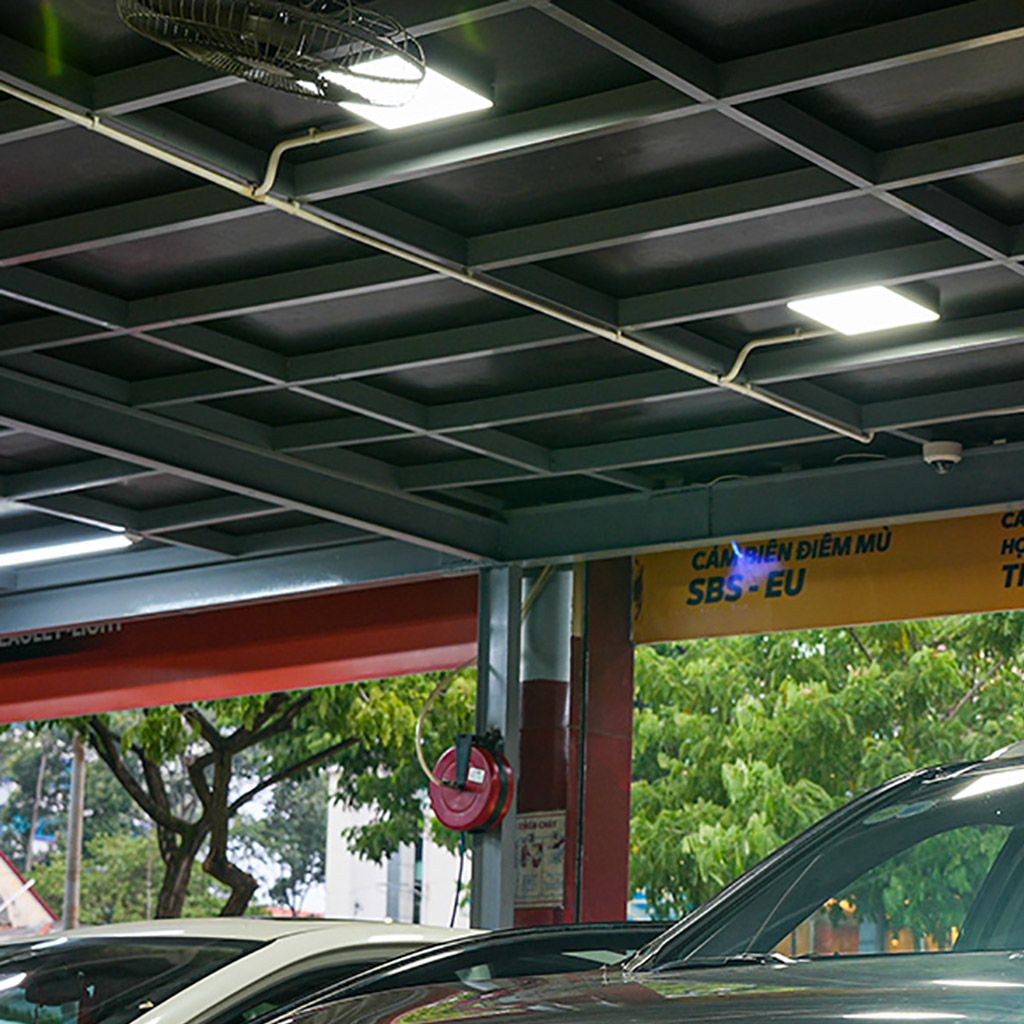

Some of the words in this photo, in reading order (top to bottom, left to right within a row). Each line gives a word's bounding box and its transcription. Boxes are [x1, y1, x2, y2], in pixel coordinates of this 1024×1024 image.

[855, 526, 893, 553] MÙ
[686, 573, 744, 606] SBS
[765, 568, 807, 598] EU
